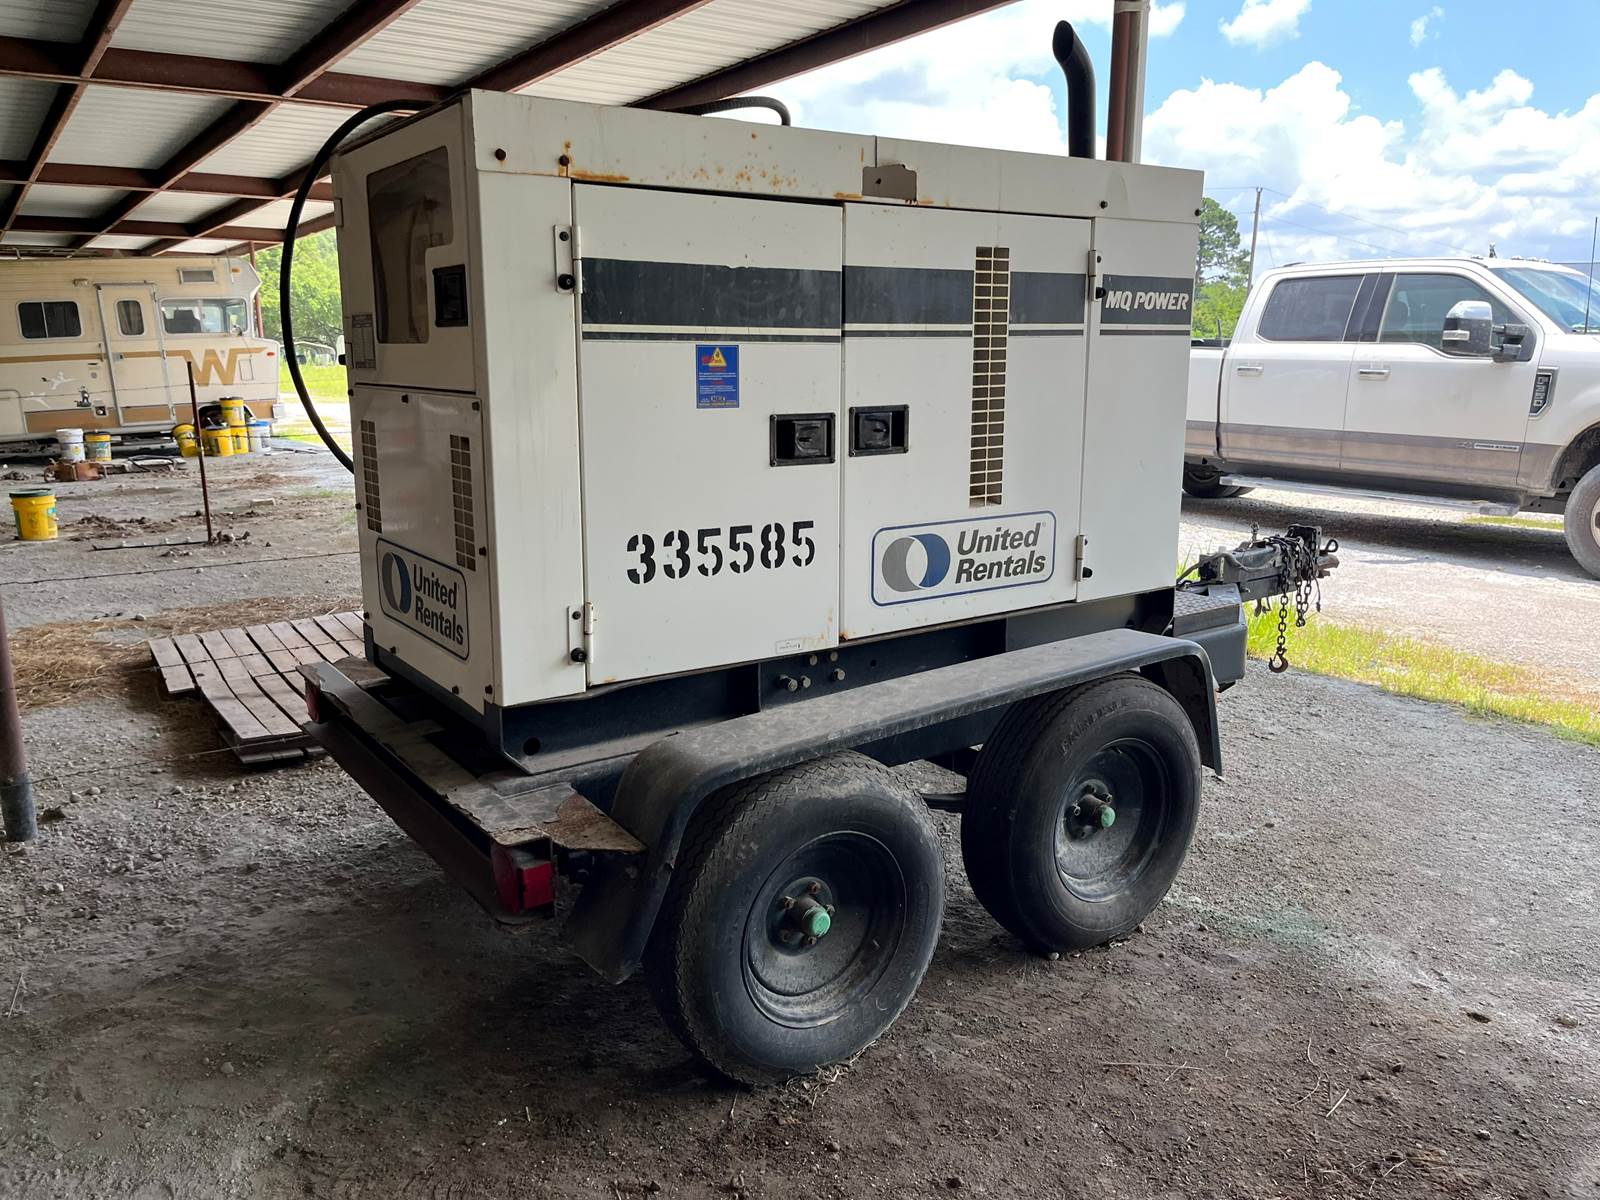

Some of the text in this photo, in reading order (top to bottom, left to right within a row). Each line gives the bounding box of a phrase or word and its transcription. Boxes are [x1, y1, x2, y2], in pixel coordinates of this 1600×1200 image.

[1105, 290, 1189, 312] MQ POWER
[626, 520, 815, 585] 335585
[957, 522, 1042, 556] United
[413, 563, 458, 610] United
[955, 550, 1047, 585] Rentals
[415, 595, 464, 646] Rentals
